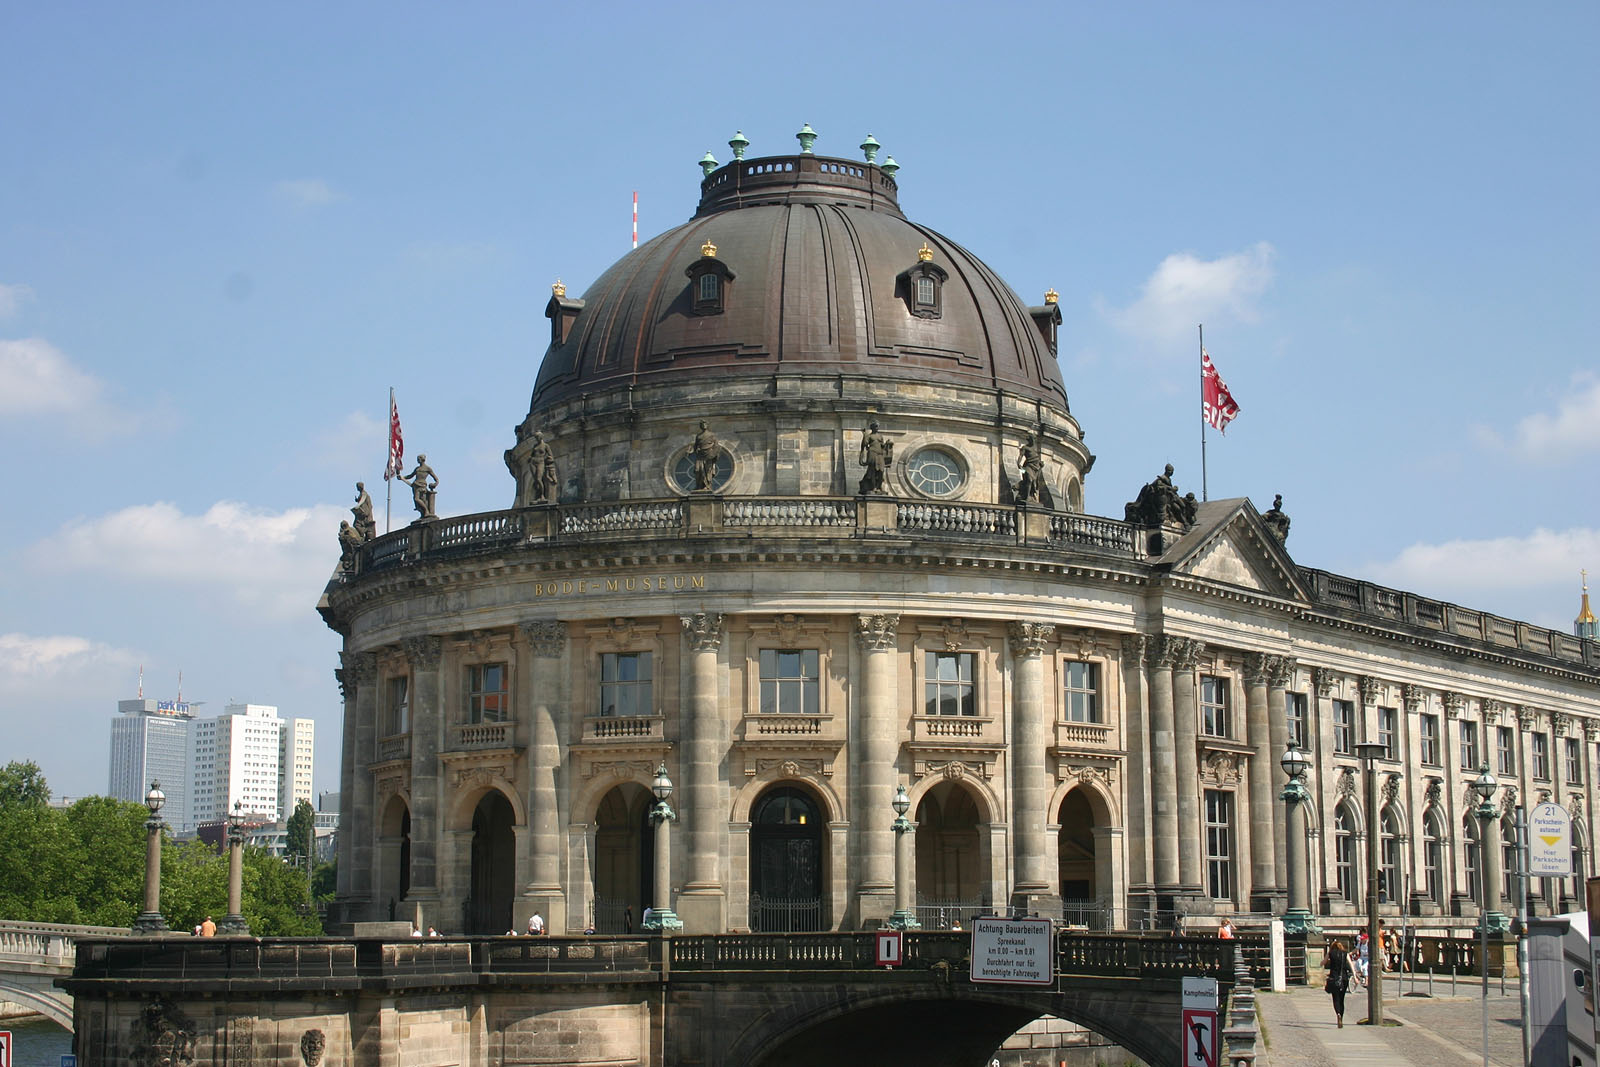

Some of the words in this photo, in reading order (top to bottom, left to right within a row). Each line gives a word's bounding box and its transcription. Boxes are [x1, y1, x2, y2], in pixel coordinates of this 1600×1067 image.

[535, 576, 705, 596] BODE-MUSEUM
[1545, 806, 1555, 816] 21
[978, 924, 1003, 935] Achtung
[1005, 924, 1046, 934] Bauarbeiten!
[997, 937, 1026, 946] Spreekanal
[987, 958, 1014, 967] Durchfahrt
[1027, 959, 1035, 967] für
[982, 968, 1011, 978] berechtigte
[1013, 969, 1040, 979] Fahrzeuge
